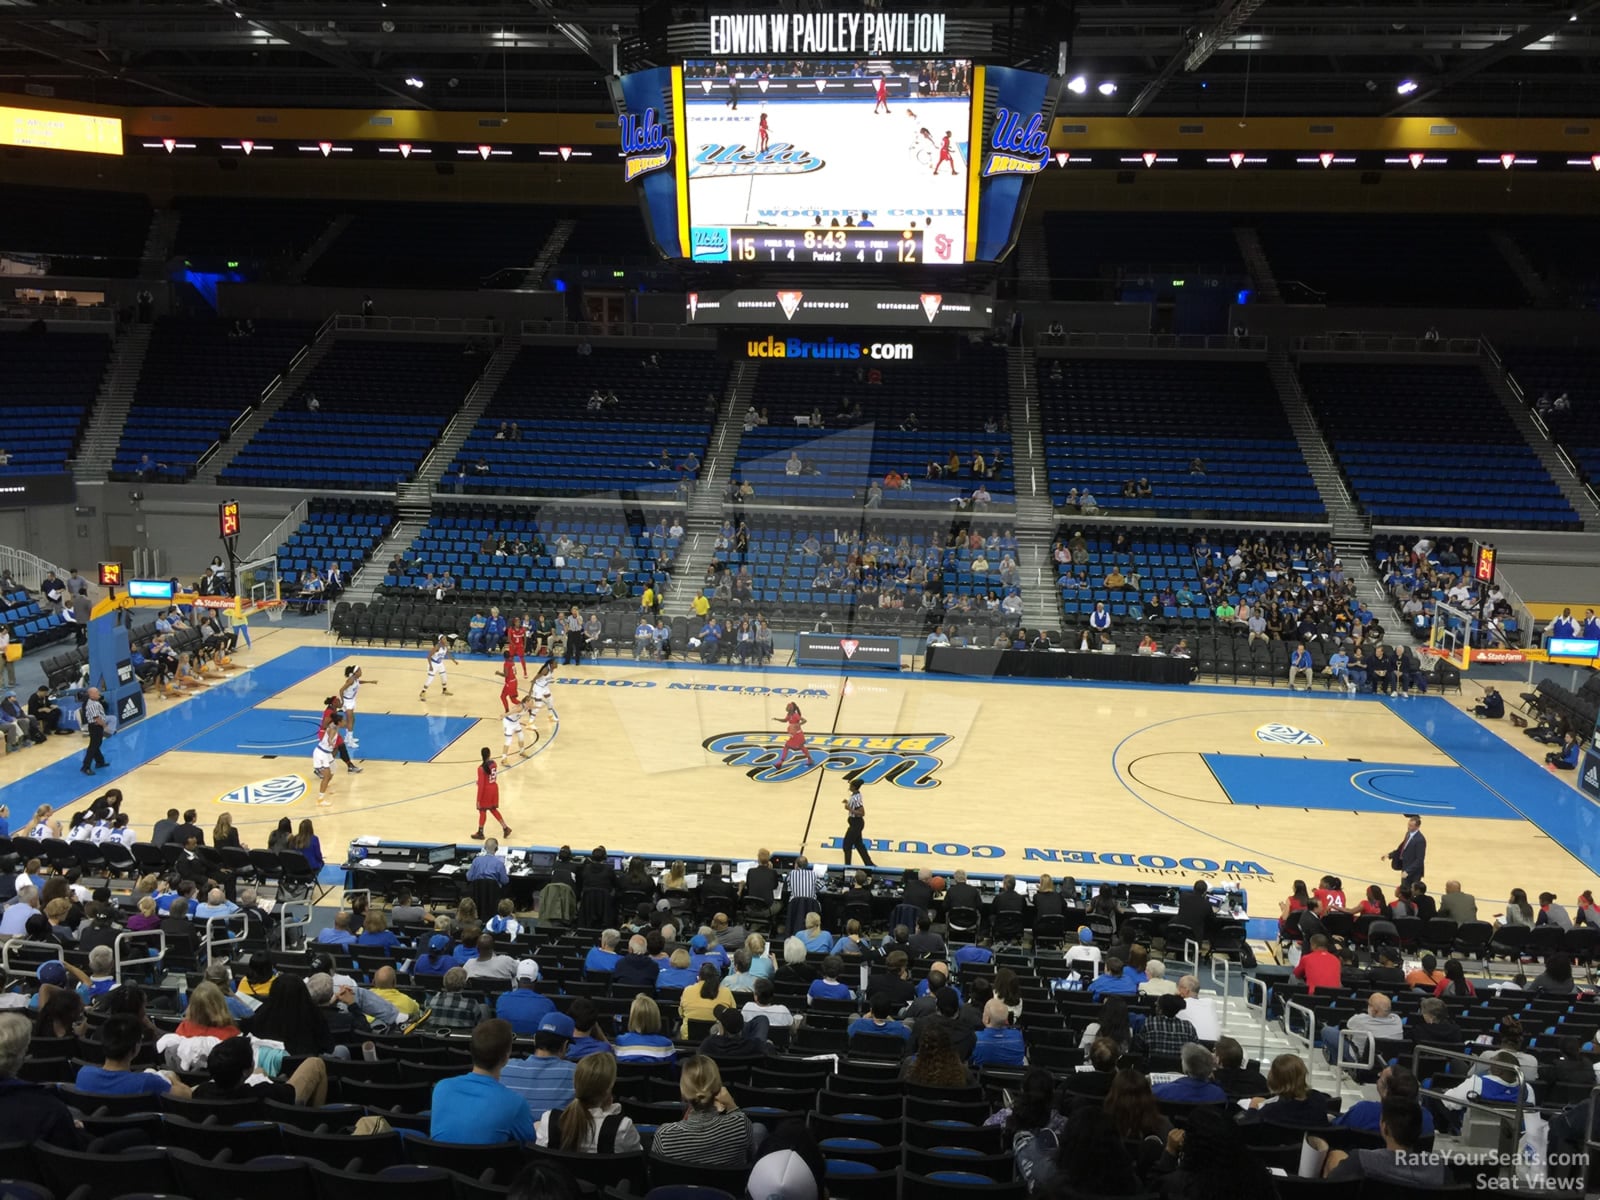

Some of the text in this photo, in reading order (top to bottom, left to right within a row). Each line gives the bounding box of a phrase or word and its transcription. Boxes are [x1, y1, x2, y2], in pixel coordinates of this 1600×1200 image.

[710, 13, 946, 54] EDWIN W PAULEY PAVILION
[804, 230, 847, 249] 8:43
[737, 238, 755, 261] 15
[770, 247, 776, 261] 1
[786, 247, 796, 261] 4
[812, 251, 842, 261] Period 2
[856, 249, 865, 262] 4
[874, 249, 883, 262] 0
[897, 240, 916, 262] 12
[666, 682, 831, 697] WOODEN
[30, 827, 43, 837] 24
[95, 828, 102, 838] 4
[1022, 847, 1274, 875] WOODEN
[1137, 866, 1189, 877] John
[1326, 894, 1342, 908] 24
